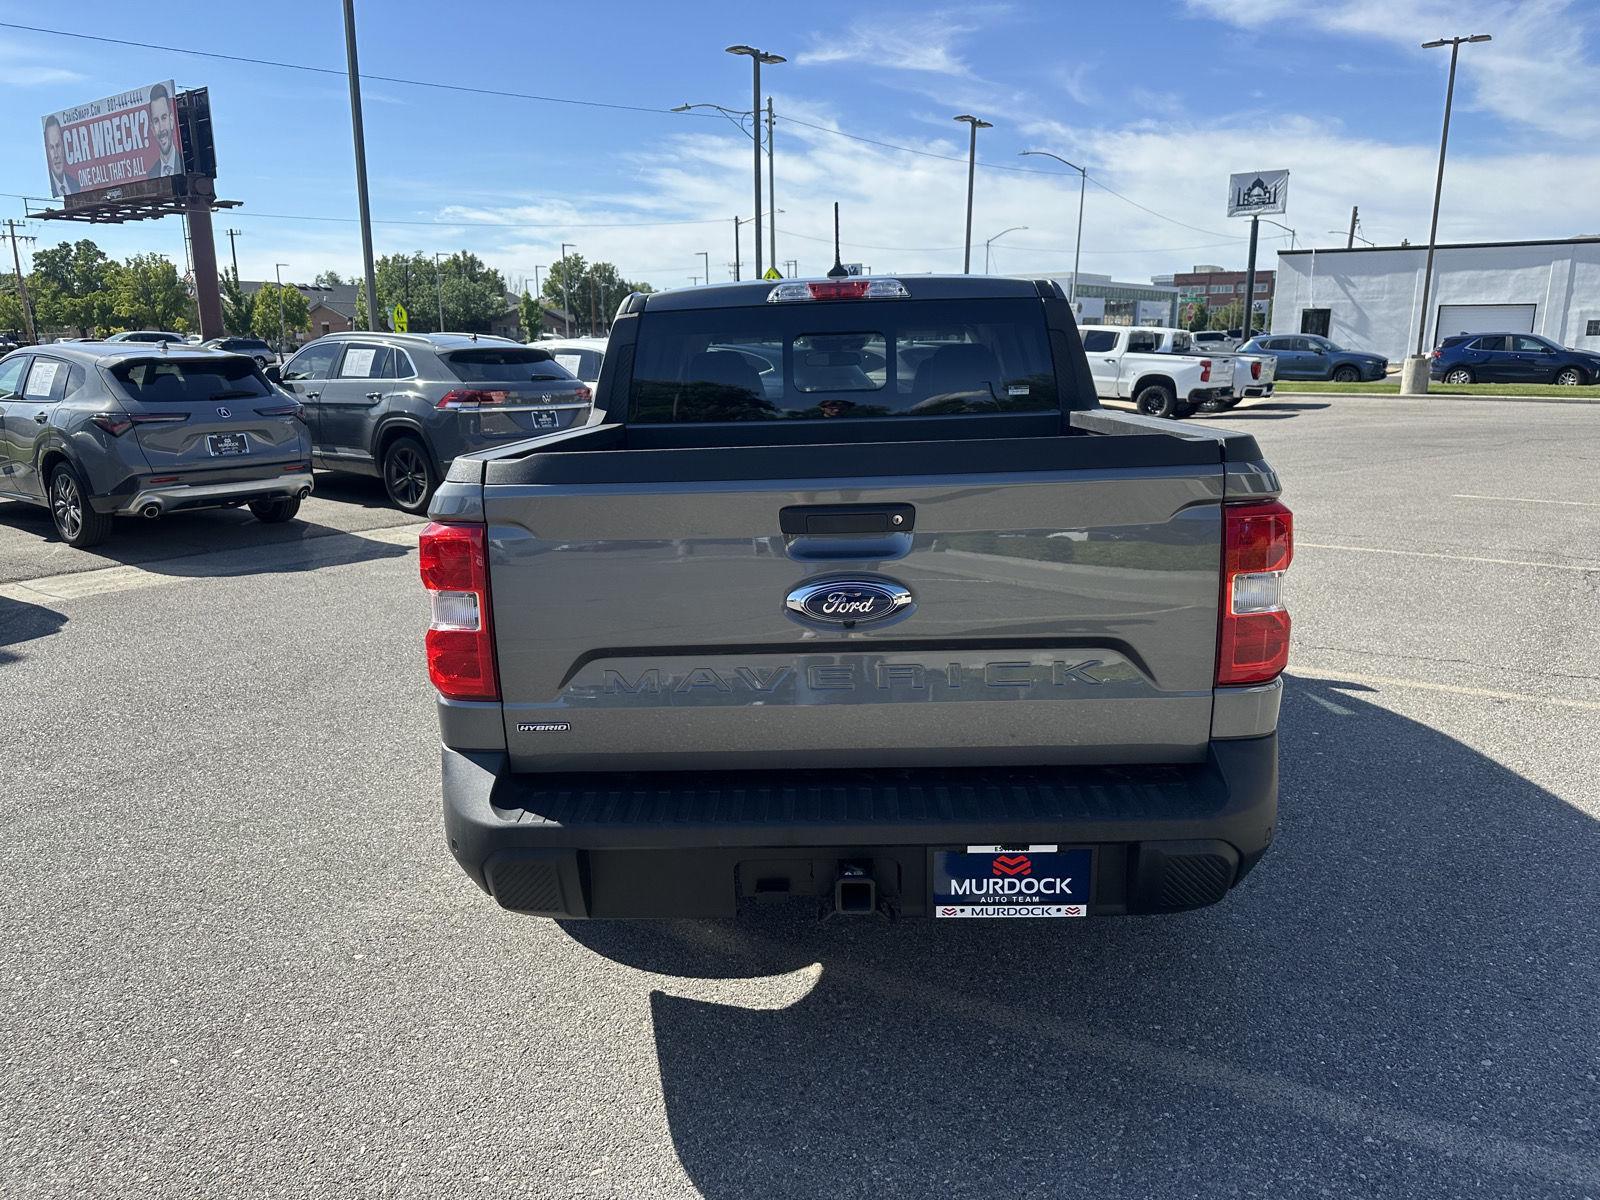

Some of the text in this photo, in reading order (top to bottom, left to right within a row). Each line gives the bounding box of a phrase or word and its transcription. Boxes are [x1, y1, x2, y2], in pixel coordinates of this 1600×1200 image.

[63, 109, 150, 165] CAR WRECK?
[78, 157, 147, 187] ONE CALL THAT'S ALL
[822, 592, 875, 613] Ford
[603, 658, 1104, 695] MAVERICK
[950, 877, 1073, 895] MURDOCK
[971, 906, 1053, 917] MURDOCK
